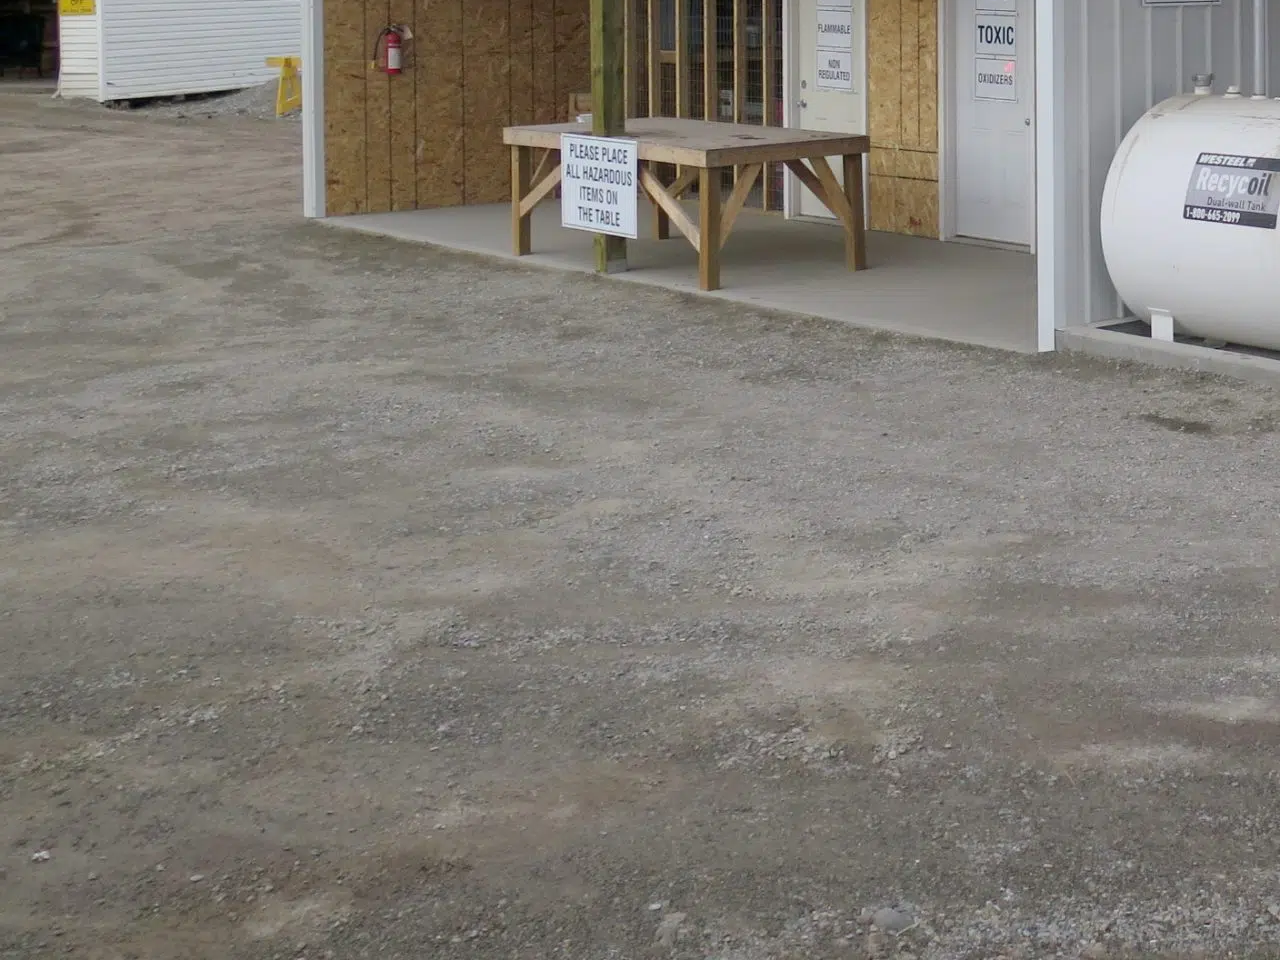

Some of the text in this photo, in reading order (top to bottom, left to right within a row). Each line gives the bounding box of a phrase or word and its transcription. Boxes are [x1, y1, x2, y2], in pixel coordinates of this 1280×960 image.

[818, 24, 851, 34] FLAMMABLE
[978, 25, 1014, 45] TOXIC
[818, 70, 850, 81] REGULATED
[978, 73, 1013, 86] OXIDIZERS
[569, 143, 628, 165] PLEASE PLACE
[1198, 154, 1246, 167] WESTEEL
[566, 163, 632, 186] ALL HAZARDOUS
[1196, 167, 1272, 198] Recycoil
[579, 186, 618, 205] ITEMS ON
[1207, 196, 1266, 211] Dual-wall Tank
[578, 206, 620, 227] THE TABLE
